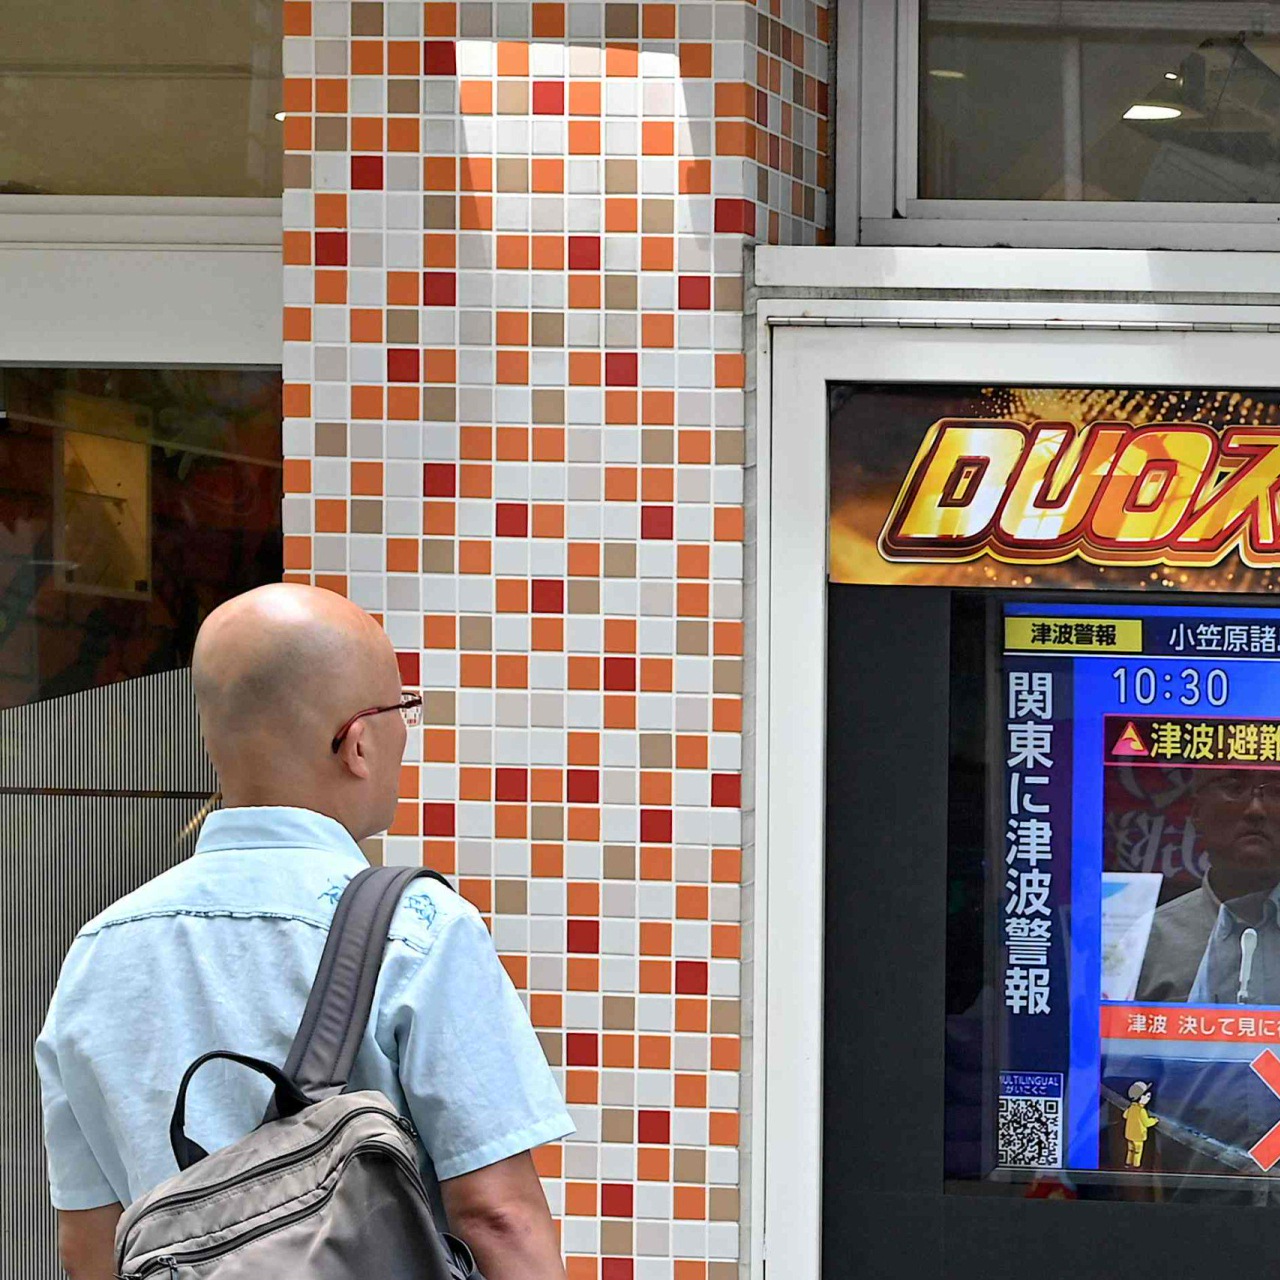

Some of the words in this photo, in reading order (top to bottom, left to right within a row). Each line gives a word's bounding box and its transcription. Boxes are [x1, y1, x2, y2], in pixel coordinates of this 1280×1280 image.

[1031, 623, 1117, 646] 津波警報
[1112, 668, 1229, 706] 10:30
[1005, 671, 1053, 1015] 関東に津波警報
[1127, 1013, 1168, 1034] 津波
